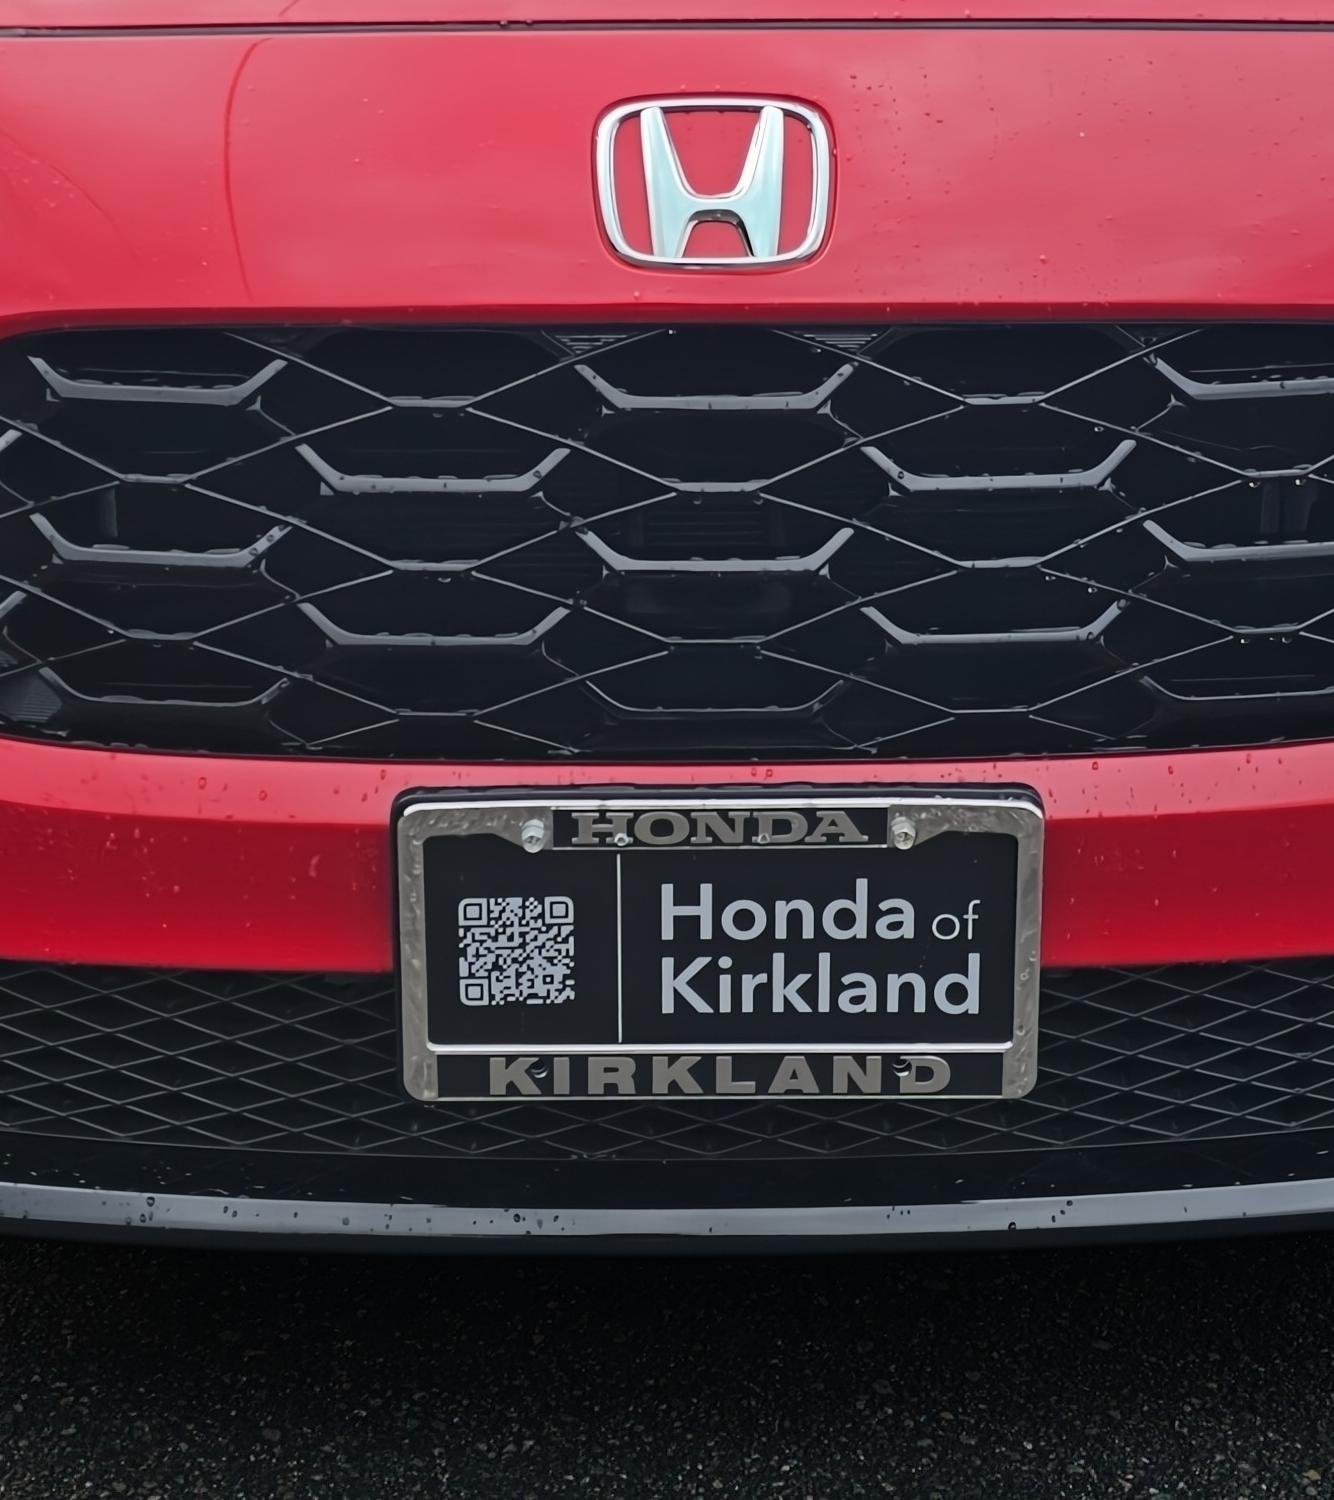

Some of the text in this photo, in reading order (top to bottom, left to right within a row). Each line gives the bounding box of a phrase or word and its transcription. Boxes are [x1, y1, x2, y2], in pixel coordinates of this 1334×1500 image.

[571, 810, 869, 845] HONDA
[660, 878, 981, 940] Honda of
[660, 952, 980, 1015] Kirkland
[488, 1055, 952, 1096] KIRKLAND
